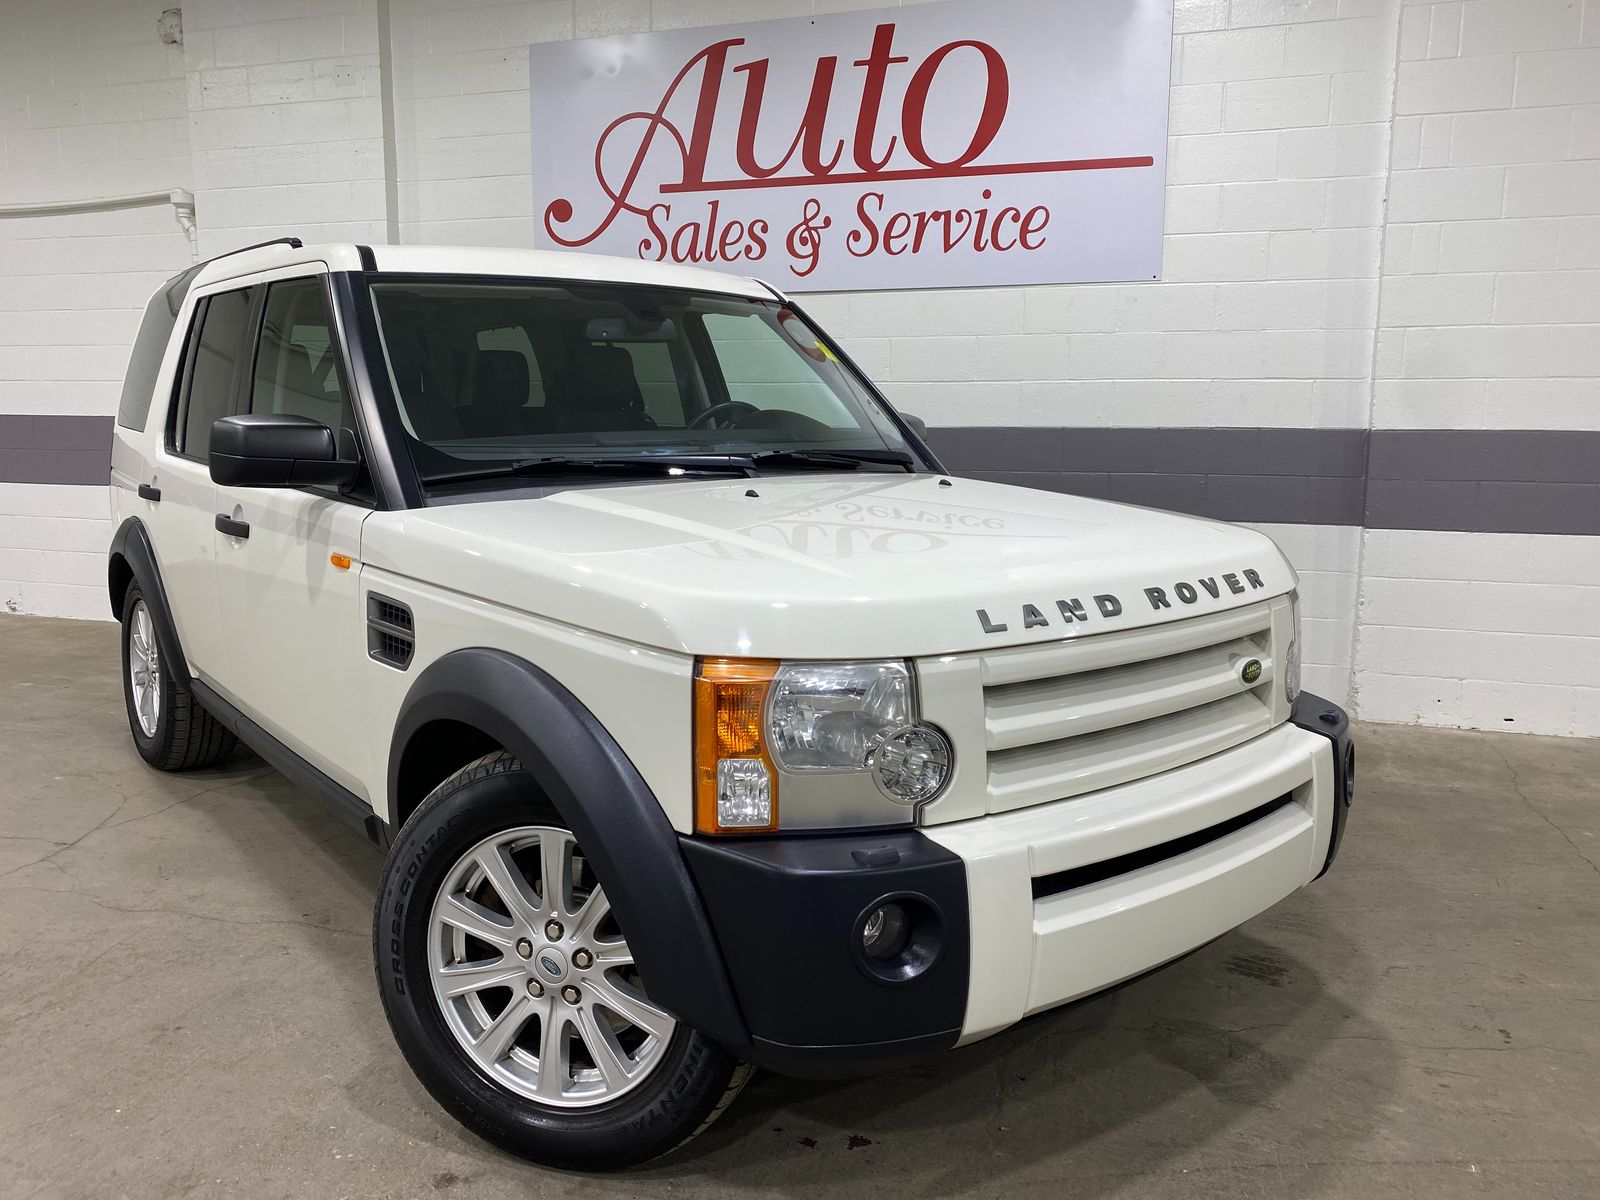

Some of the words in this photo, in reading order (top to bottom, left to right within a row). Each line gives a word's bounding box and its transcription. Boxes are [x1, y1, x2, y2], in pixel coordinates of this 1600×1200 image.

[544, 22, 1009, 247] Auto
[639, 199, 769, 263] Sales
[785, 198, 832, 277] &
[846, 188, 1051, 257] Service
[976, 594, 1123, 634] LAND
[1144, 568, 1265, 611] ROVER
